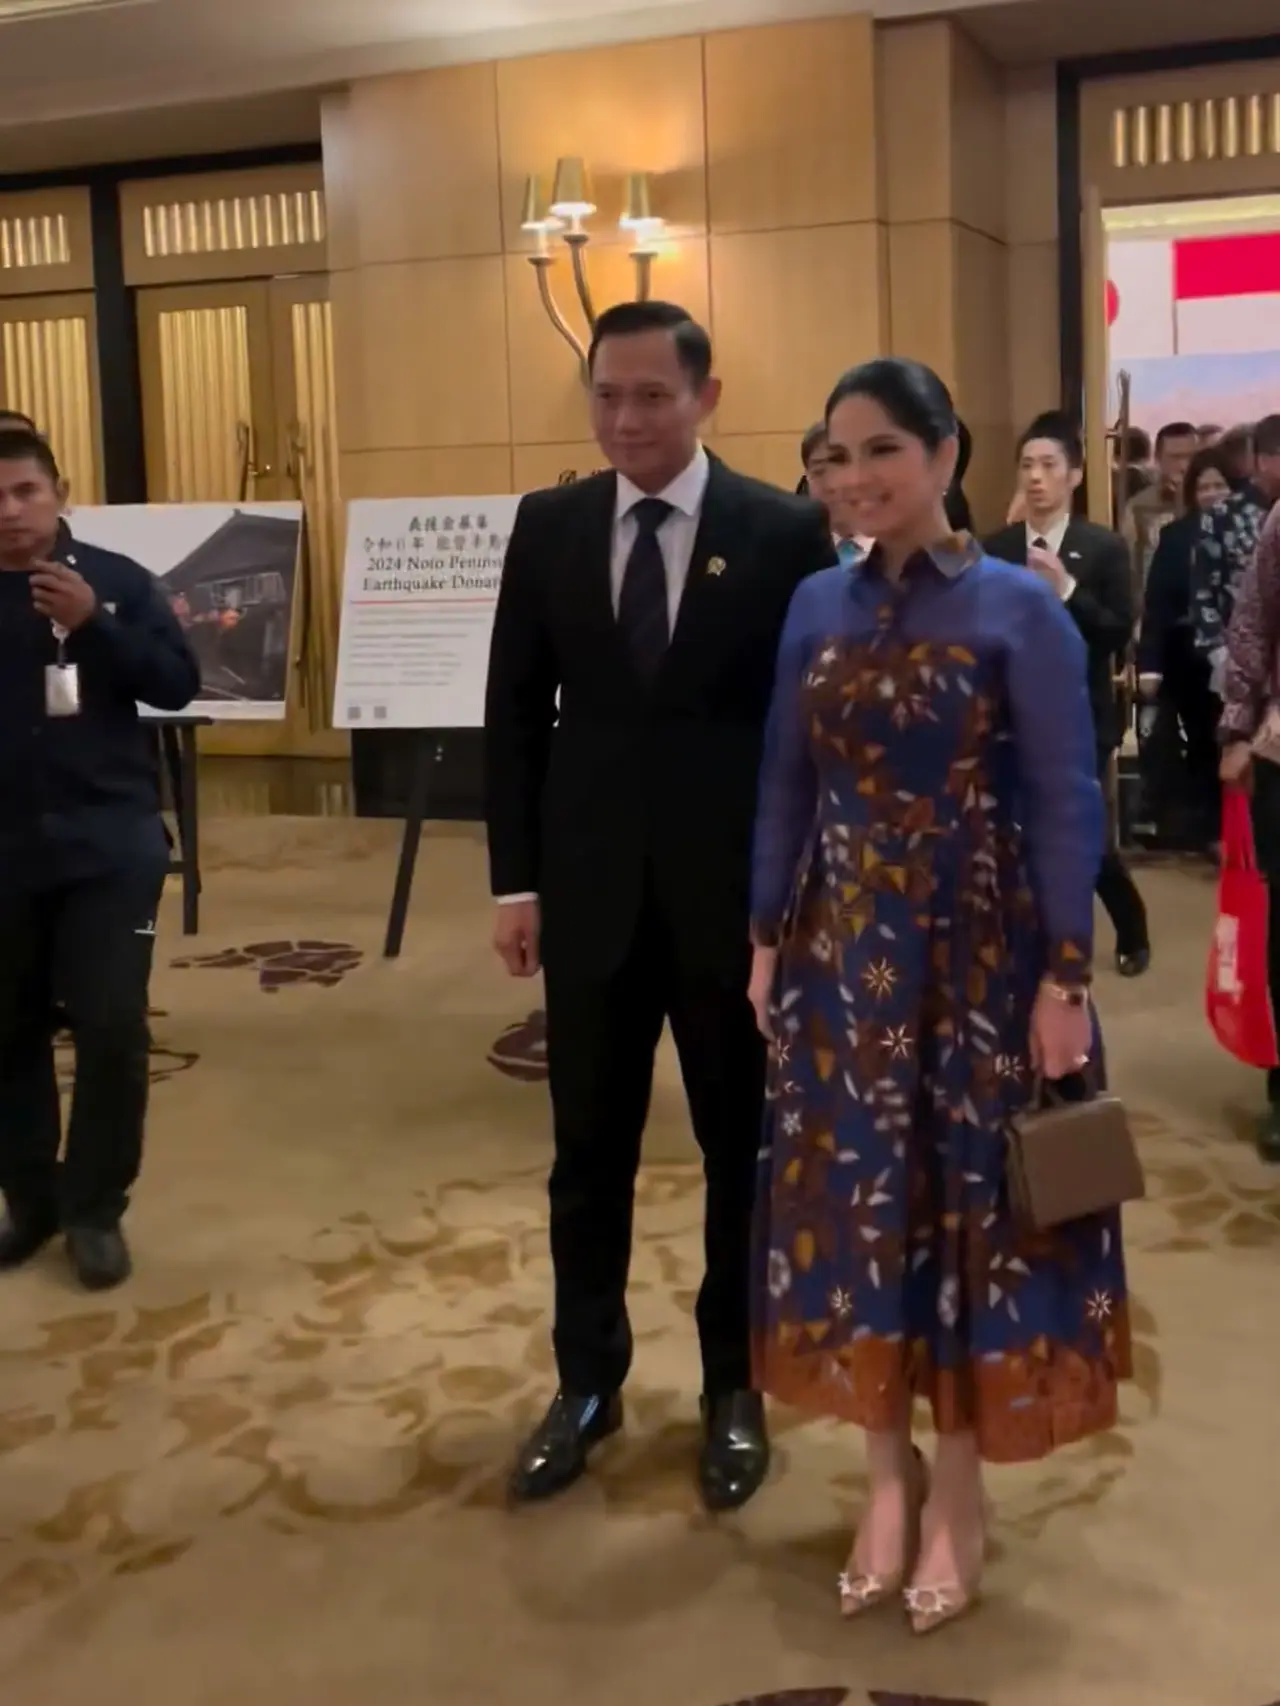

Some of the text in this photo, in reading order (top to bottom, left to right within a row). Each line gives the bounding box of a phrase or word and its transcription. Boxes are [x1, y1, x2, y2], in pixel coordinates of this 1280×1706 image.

[367, 557, 402, 571] 2024
[407, 556, 444, 570] Noto
[363, 574, 447, 593] Earthquake
